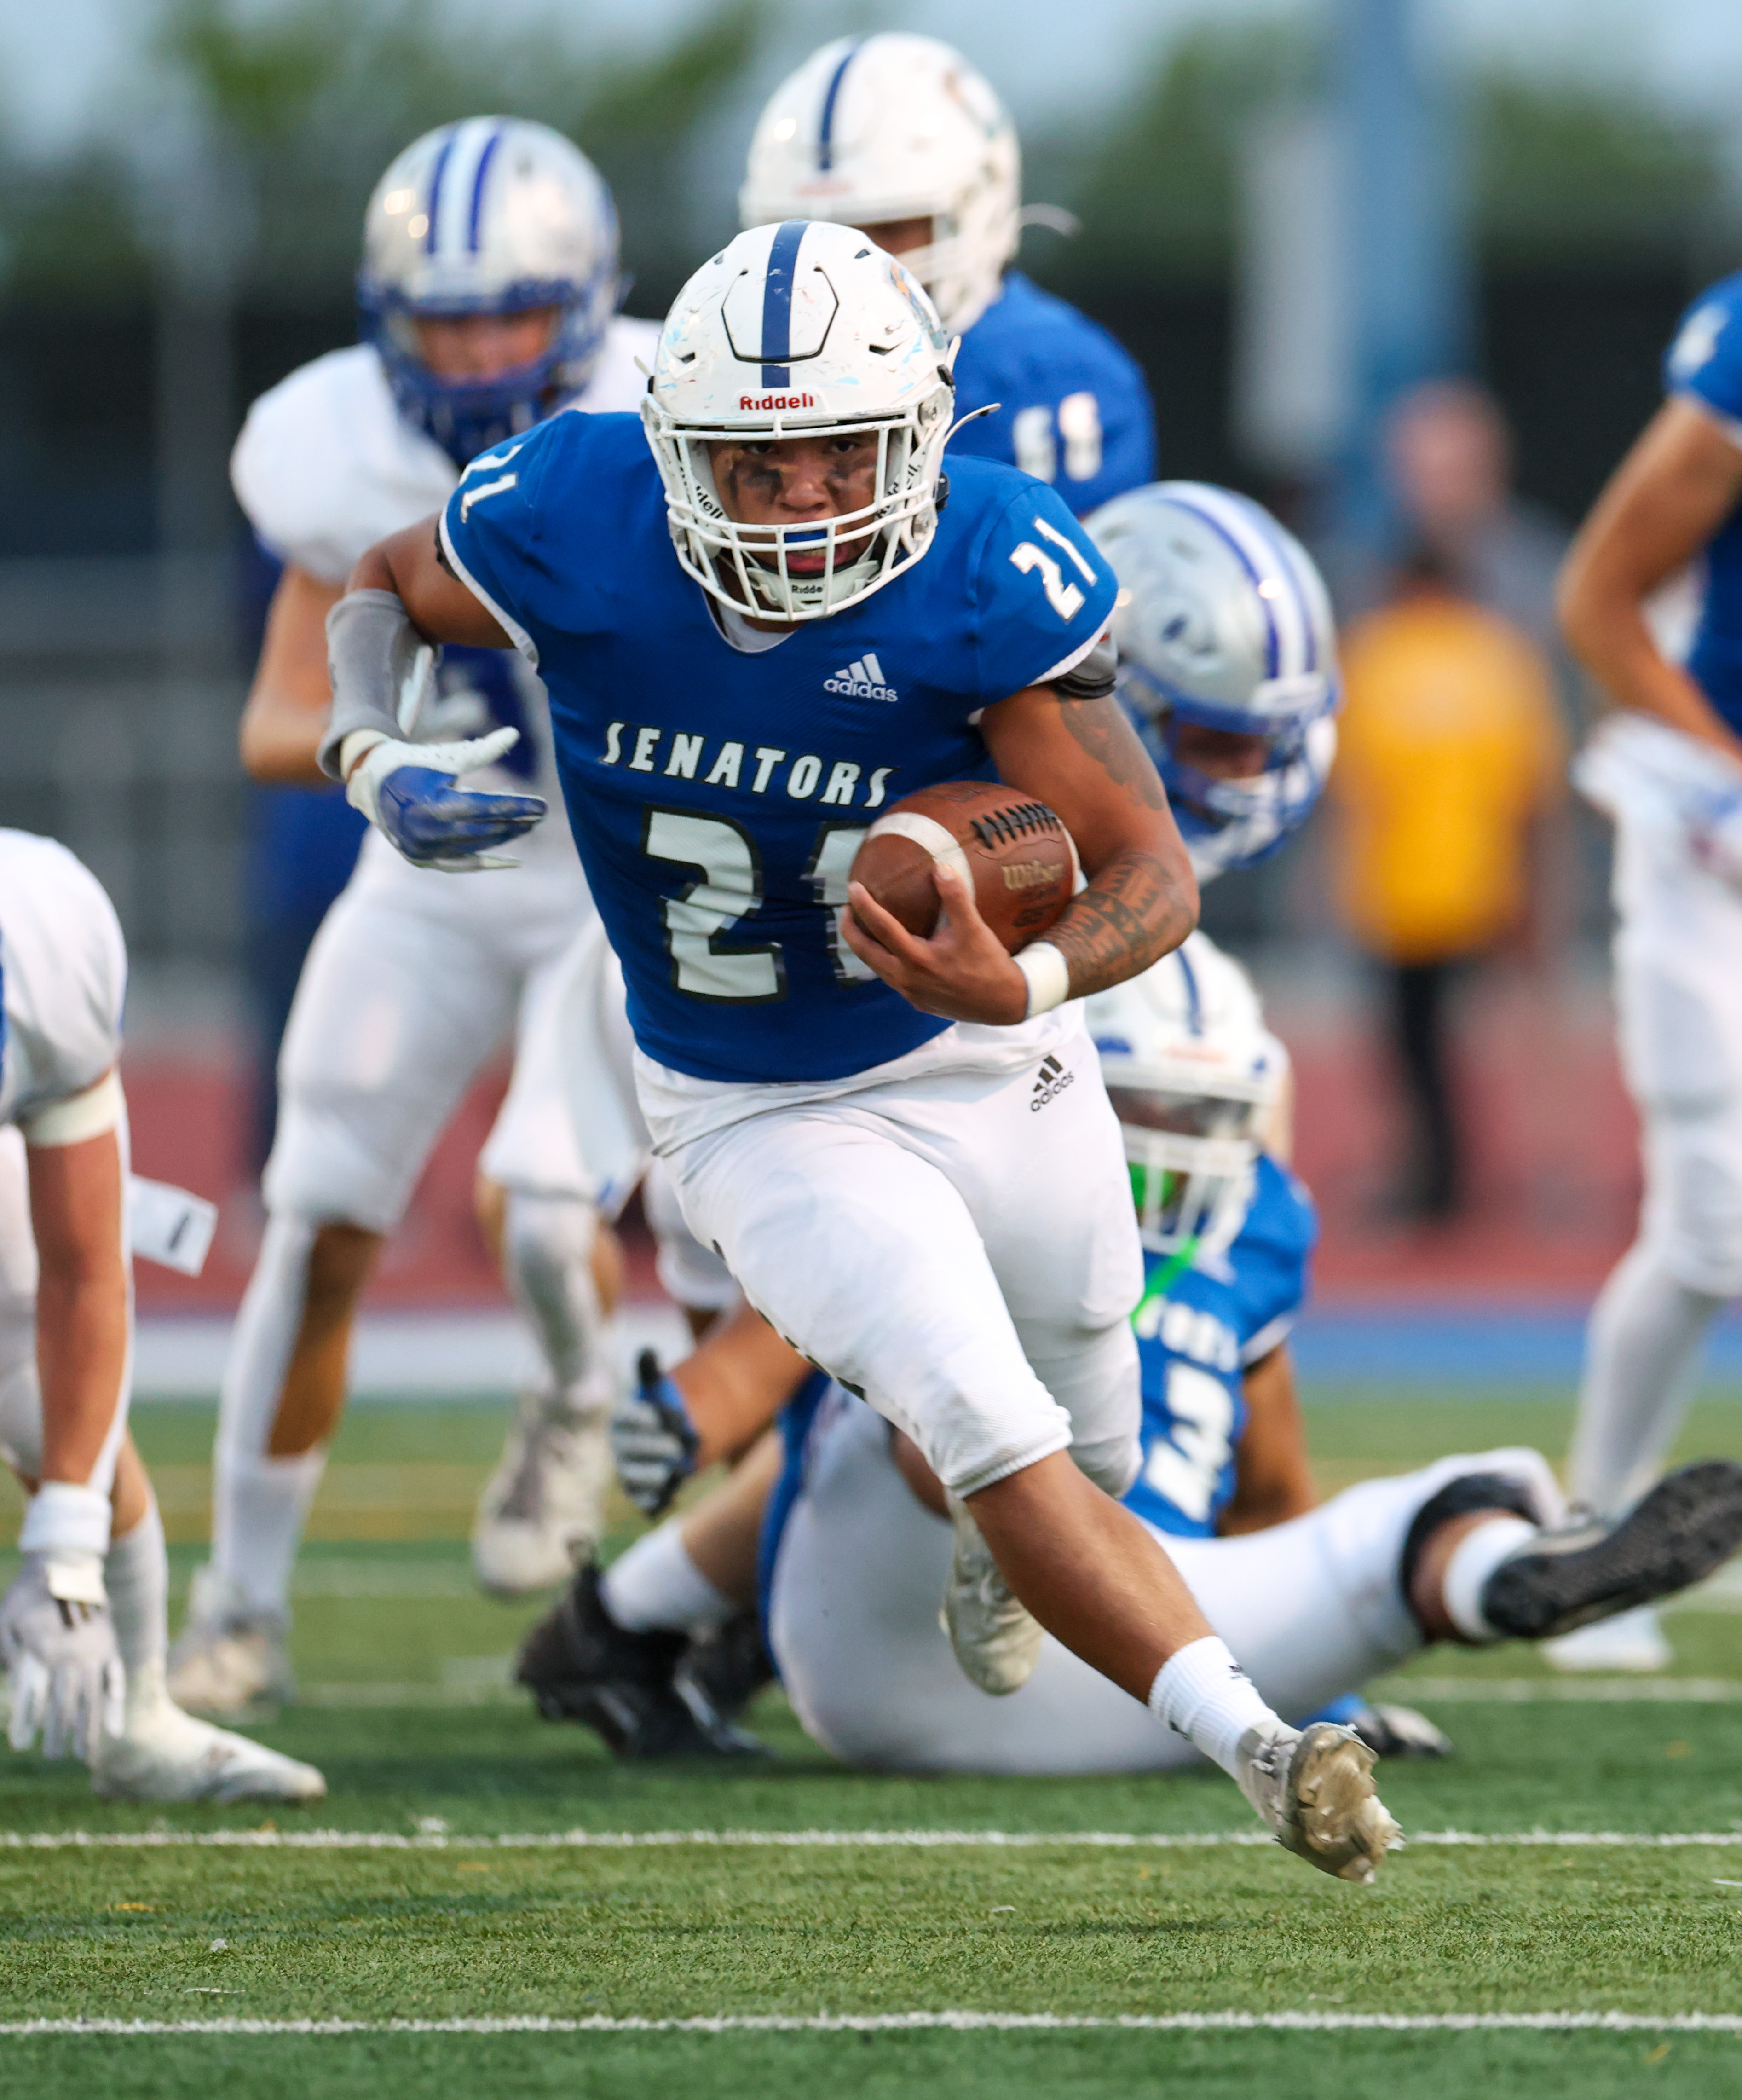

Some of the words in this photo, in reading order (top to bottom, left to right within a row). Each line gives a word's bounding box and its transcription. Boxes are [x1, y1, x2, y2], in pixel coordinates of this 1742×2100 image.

[740, 393, 813, 410] Riddell
[1009, 516, 1098, 625] 21
[823, 679, 898, 702] adidas
[599, 722, 899, 808] SENATORS
